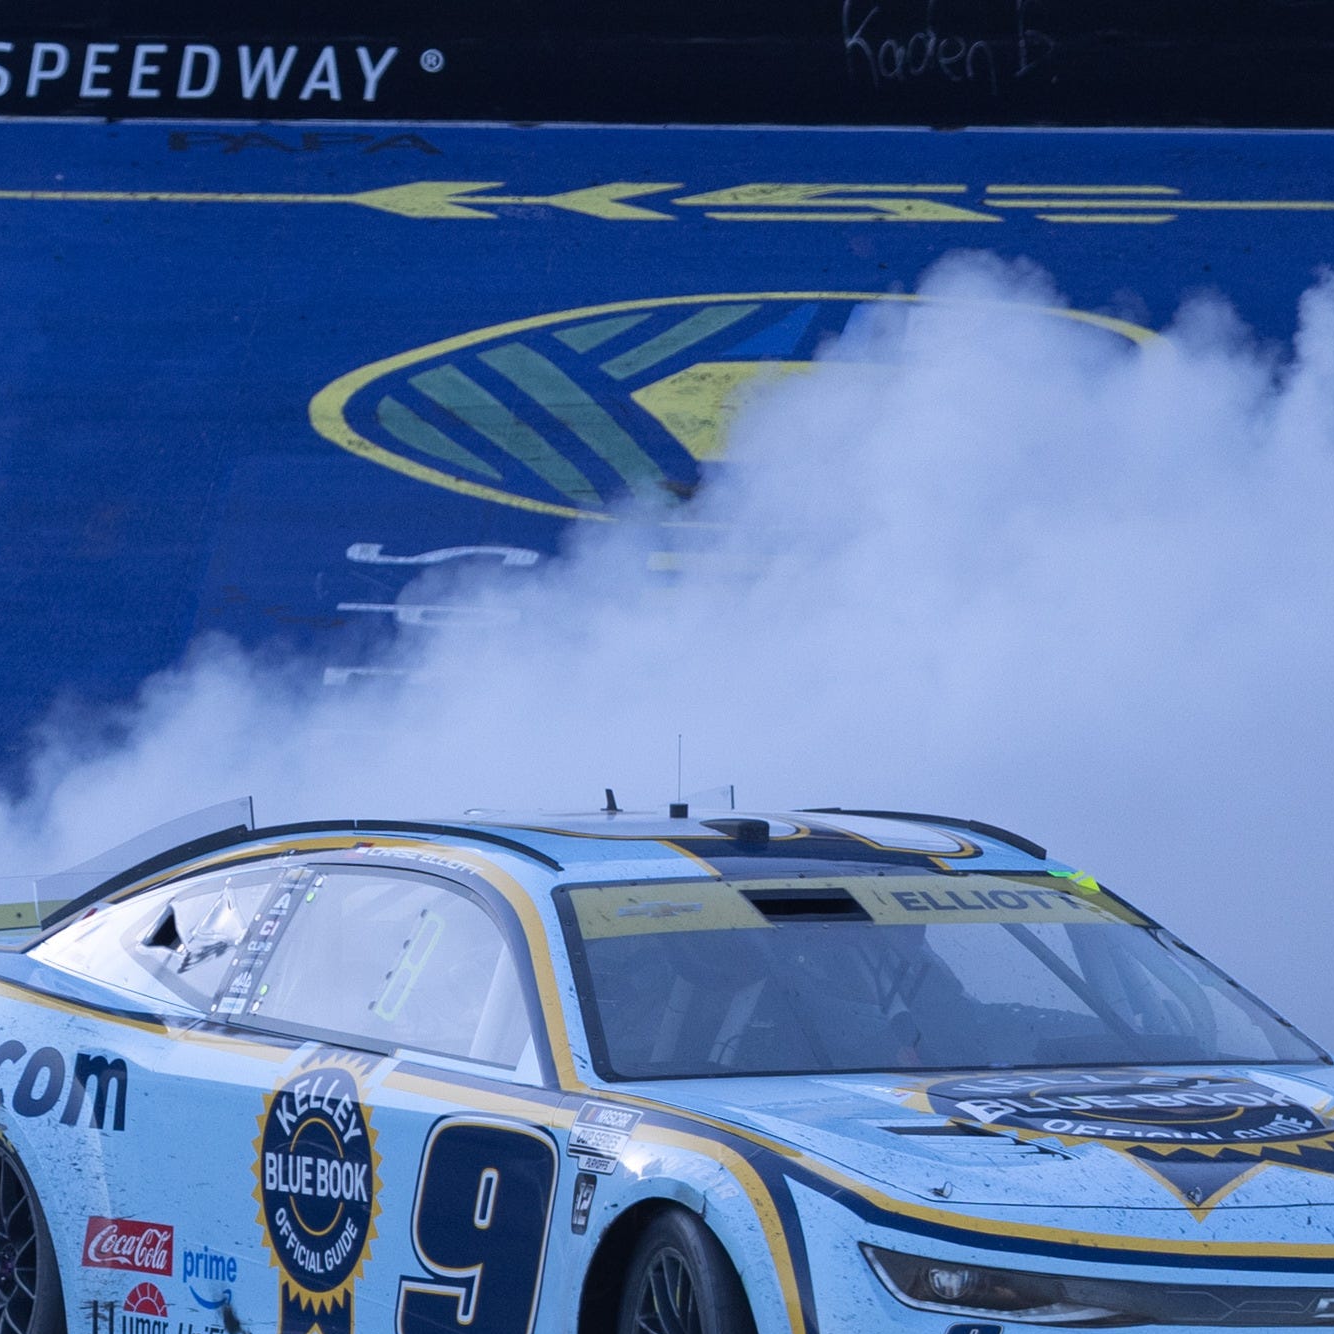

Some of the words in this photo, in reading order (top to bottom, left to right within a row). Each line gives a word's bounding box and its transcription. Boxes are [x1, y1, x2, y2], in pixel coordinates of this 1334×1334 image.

[890, 889, 1084, 911] ELLIOTT
[952, 1072, 1249, 1095] KELLEY
[275, 1075, 363, 1144] KELLEY
[953, 1094, 1137, 1124] BLUE
[1141, 1086, 1297, 1109] BOOK
[264, 1152, 314, 1196] BLUE
[316, 1157, 368, 1203] BOOK
[275, 1206, 325, 1274] OFFICIAL
[323, 1216, 359, 1272] GUIDE
[182, 1245, 238, 1284] prime
